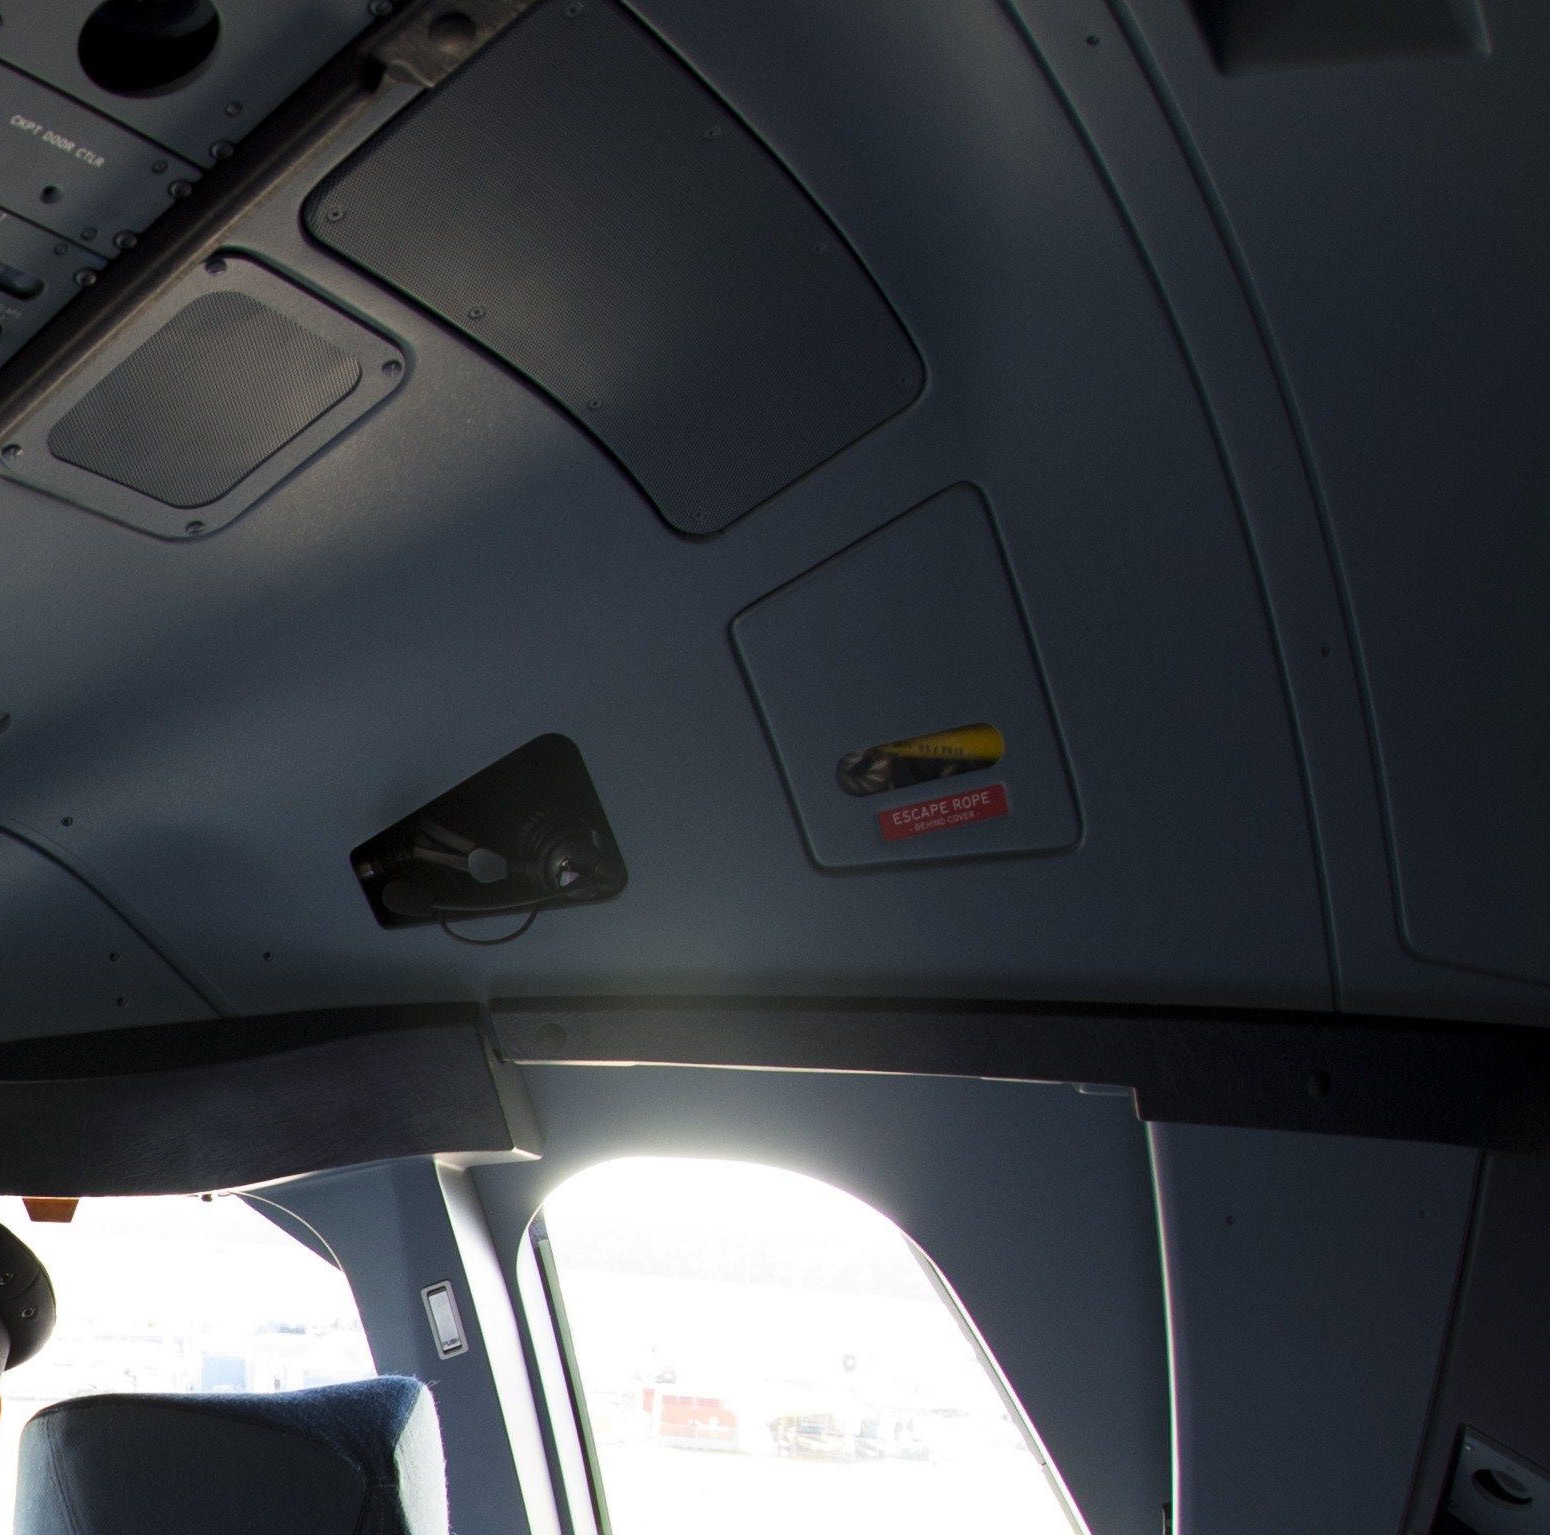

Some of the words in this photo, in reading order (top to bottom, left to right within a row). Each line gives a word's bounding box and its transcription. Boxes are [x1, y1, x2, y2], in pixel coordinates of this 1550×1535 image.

[892, 801, 950, 826] ESCAPE
[952, 792, 992, 815] ROPE
[913, 818, 945, 833] BEHIND
[947, 810, 975, 825] COVER
